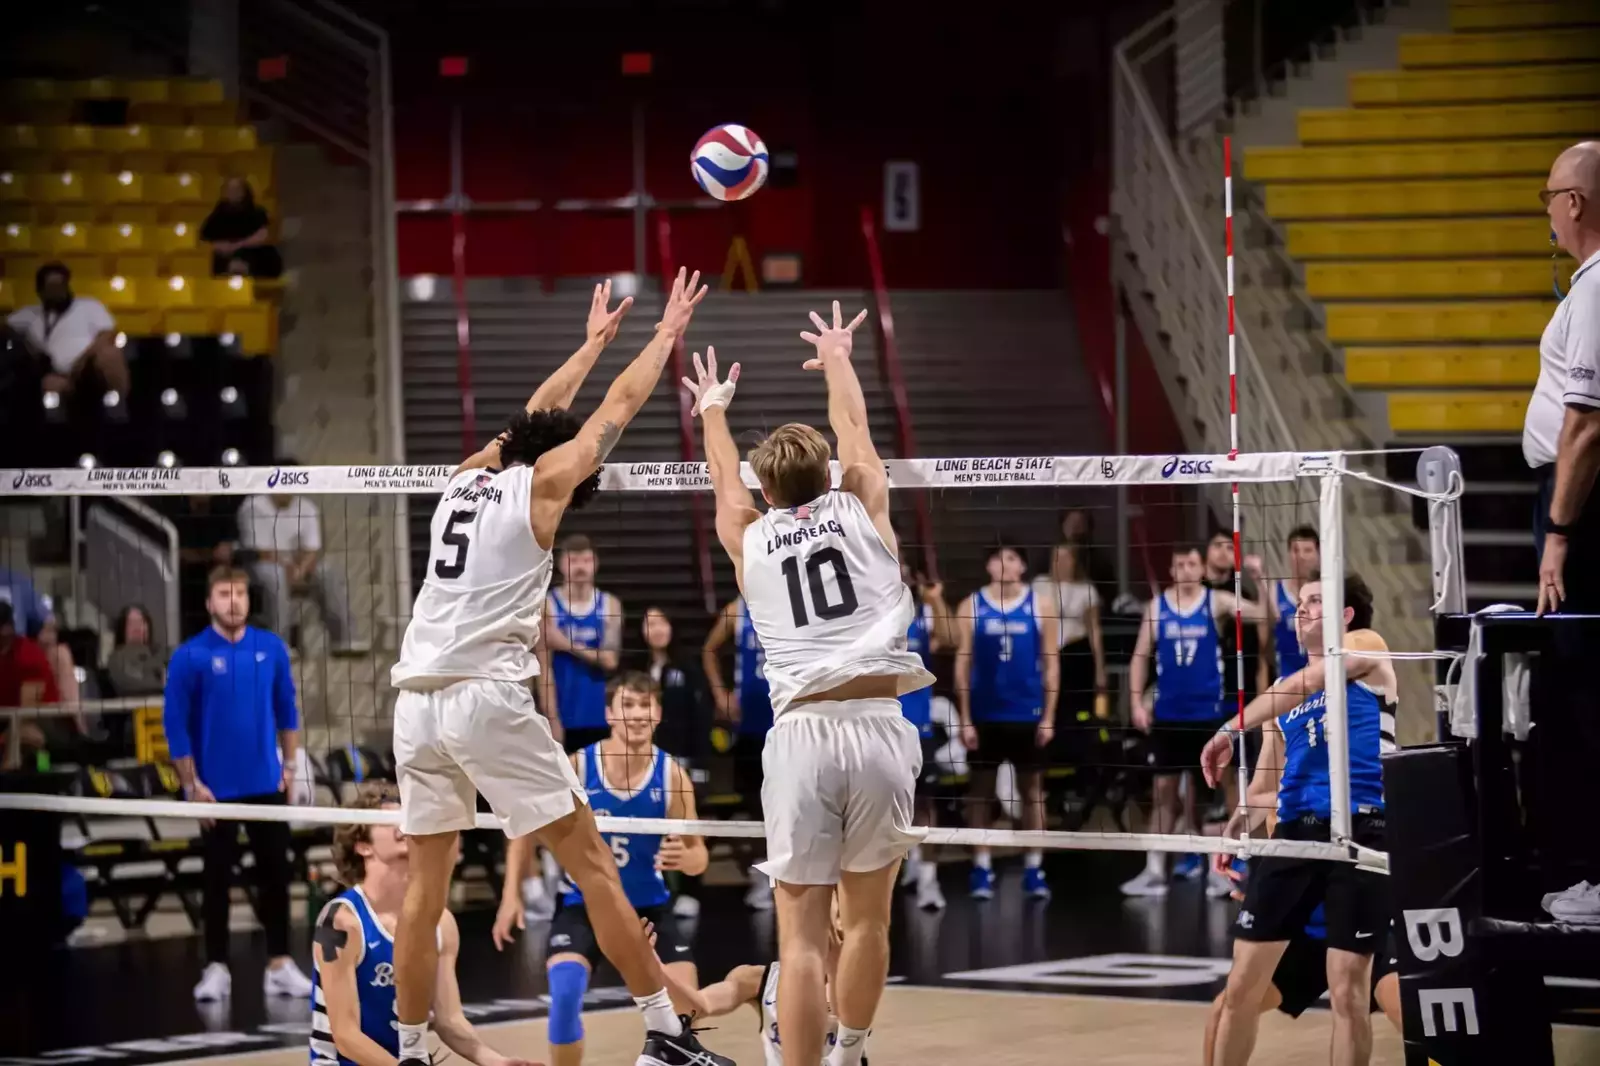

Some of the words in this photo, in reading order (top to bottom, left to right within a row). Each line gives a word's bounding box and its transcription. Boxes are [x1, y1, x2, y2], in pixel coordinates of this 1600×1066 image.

[630, 464, 660, 475] LONG
[663, 463, 701, 474] BEACH
[936, 459, 968, 471] LONG
[971, 458, 1011, 470] BEACH
[1015, 457, 1055, 469] STATE
[1179, 460, 1213, 474] asics
[87, 470, 114, 482] LONG
[116, 469, 149, 481] BEACH
[151, 468, 181, 480] STATE
[281, 471, 310, 485] asics
[348, 467, 376, 478] LONG
[378, 466, 413, 477] BEACH
[417, 466, 450, 477] STATE
[953, 474, 982, 482] MEN'S
[984, 472, 1036, 482] VOLLEYBALL
[364, 479, 387, 488] MEN'S
[389, 479, 434, 488] VOLLEYBALL
[647, 477, 673, 486] MEN'S
[675, 476, 712, 486] VOLLEYB
[434, 509, 478, 579] 5
[767, 530, 803, 556] LONG
[781, 546, 859, 628] 10
[1174, 639, 1199, 667] 17
